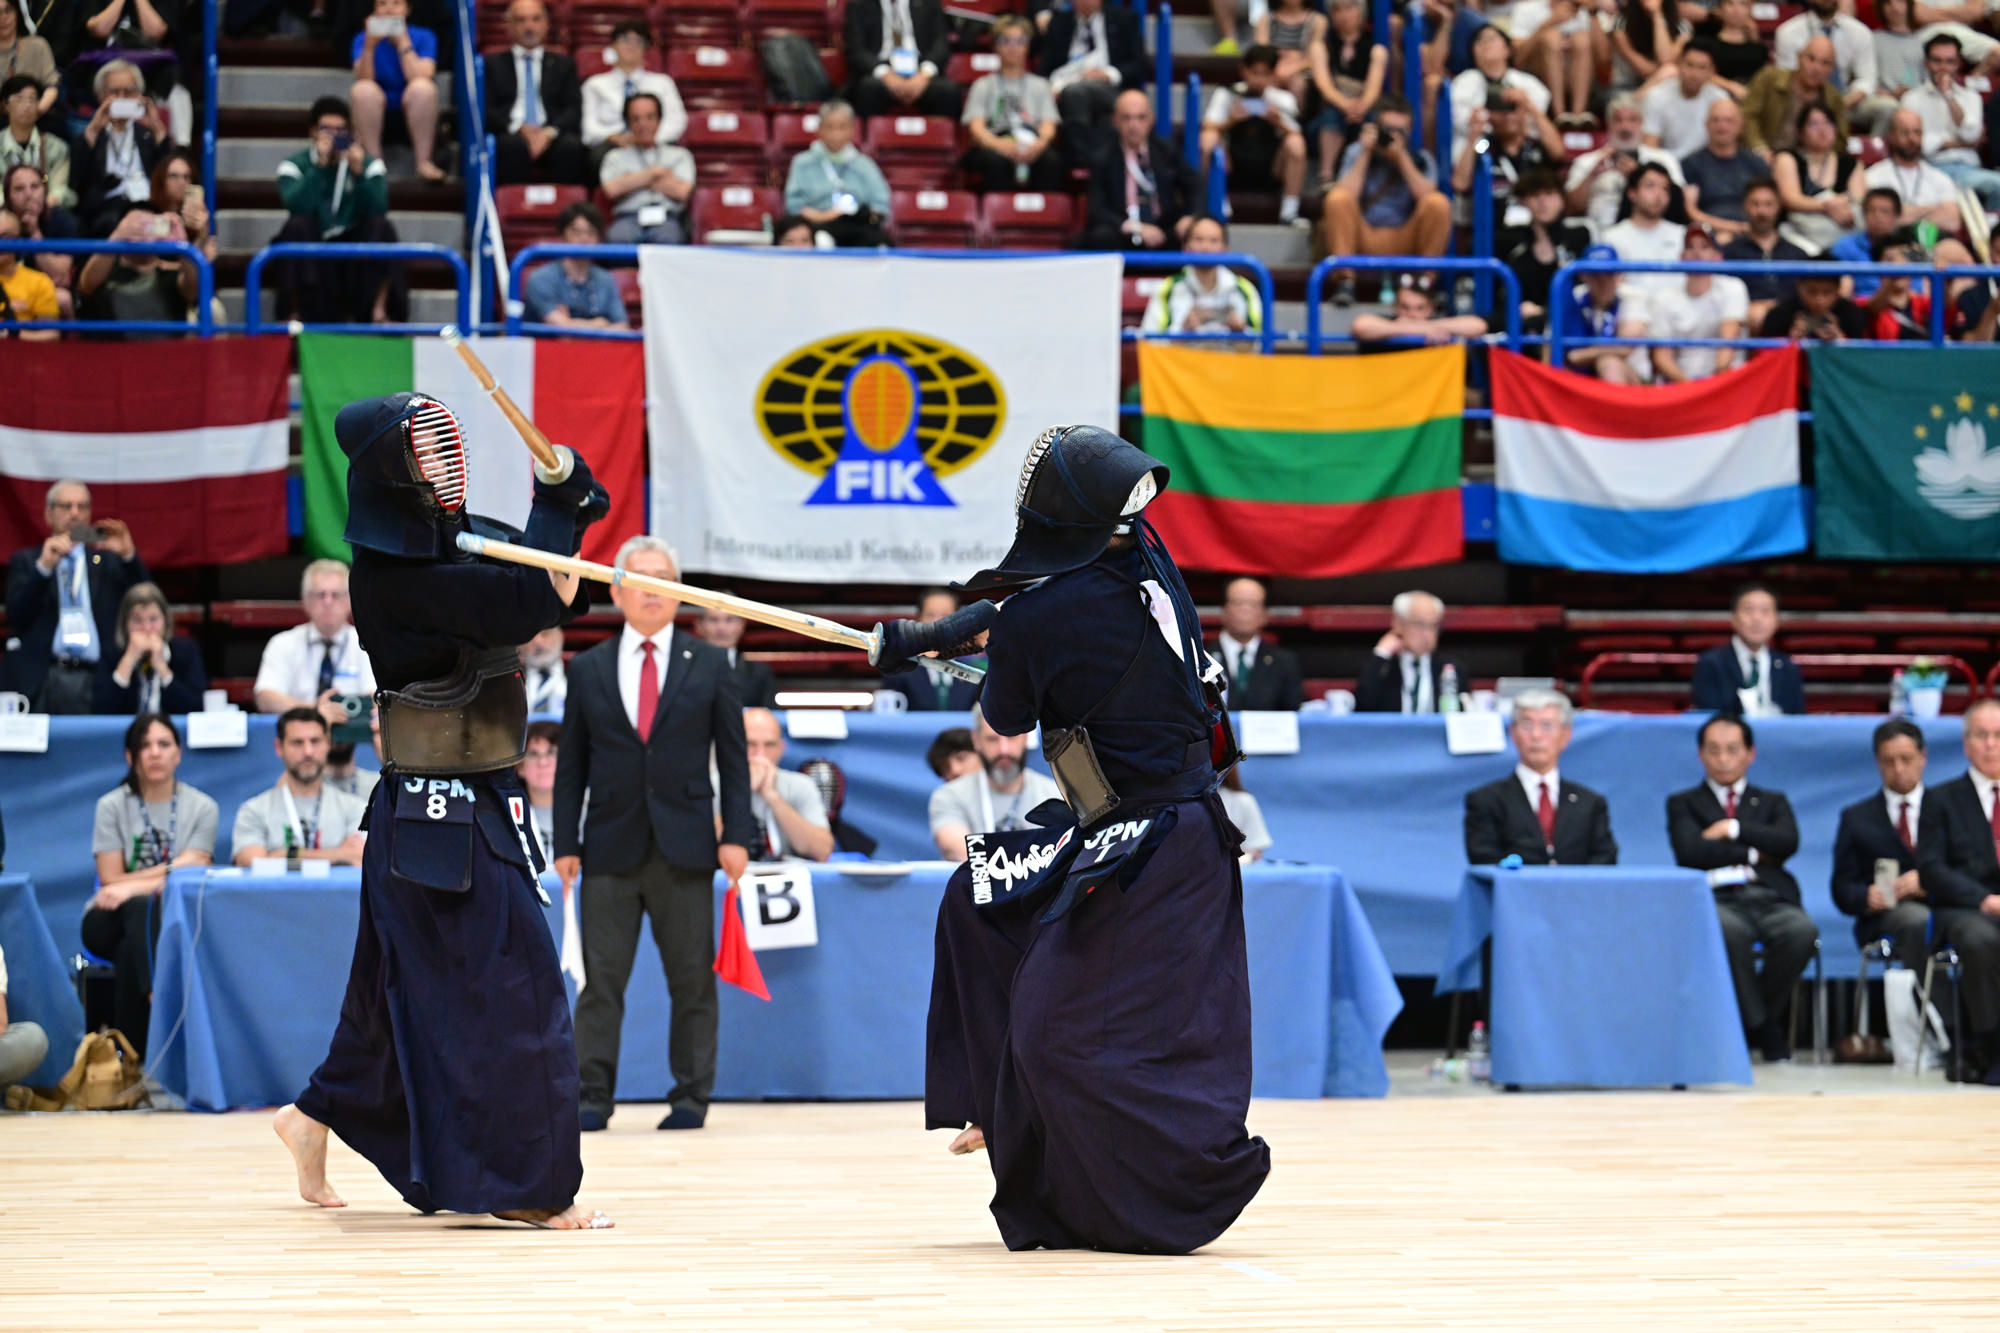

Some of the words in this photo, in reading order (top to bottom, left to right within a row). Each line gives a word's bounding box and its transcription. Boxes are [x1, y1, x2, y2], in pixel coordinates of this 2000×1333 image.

[834, 459, 926, 501] FIK
[703, 529, 853, 562] International
[861, 537, 936, 562] Kendo
[426, 794, 448, 820] 8
[1084, 819, 1152, 850] JPN
[1094, 842, 1118, 864] 7
